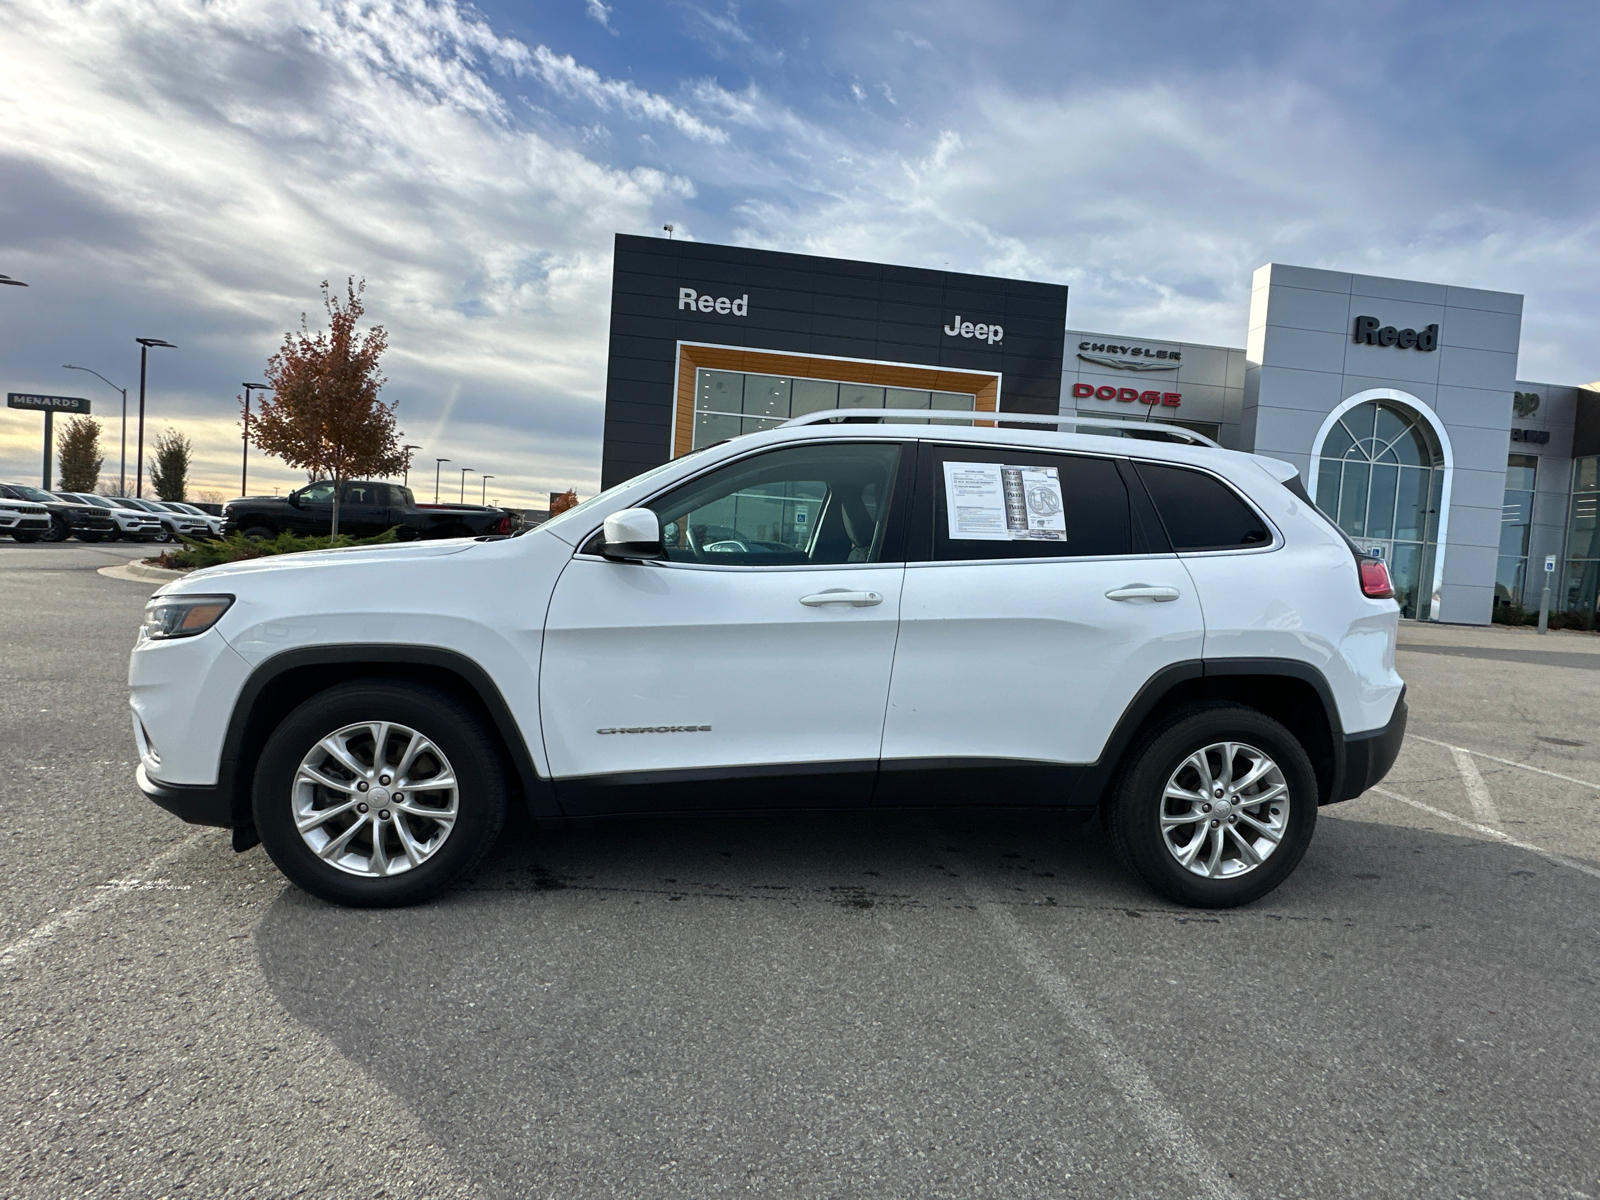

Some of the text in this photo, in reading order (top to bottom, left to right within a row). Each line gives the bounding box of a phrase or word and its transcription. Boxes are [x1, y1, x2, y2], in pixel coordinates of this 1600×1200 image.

[678, 287, 748, 317] Reed
[944, 315, 1003, 345] Jeep
[1354, 315, 1439, 352] Reed
[1078, 341, 1182, 360] CHRYSLER
[13, 395, 79, 408] MENARDS
[1073, 382, 1182, 407] DODGE
[1513, 390, 1540, 417] ep
[596, 725, 712, 735] CHEROKEE
